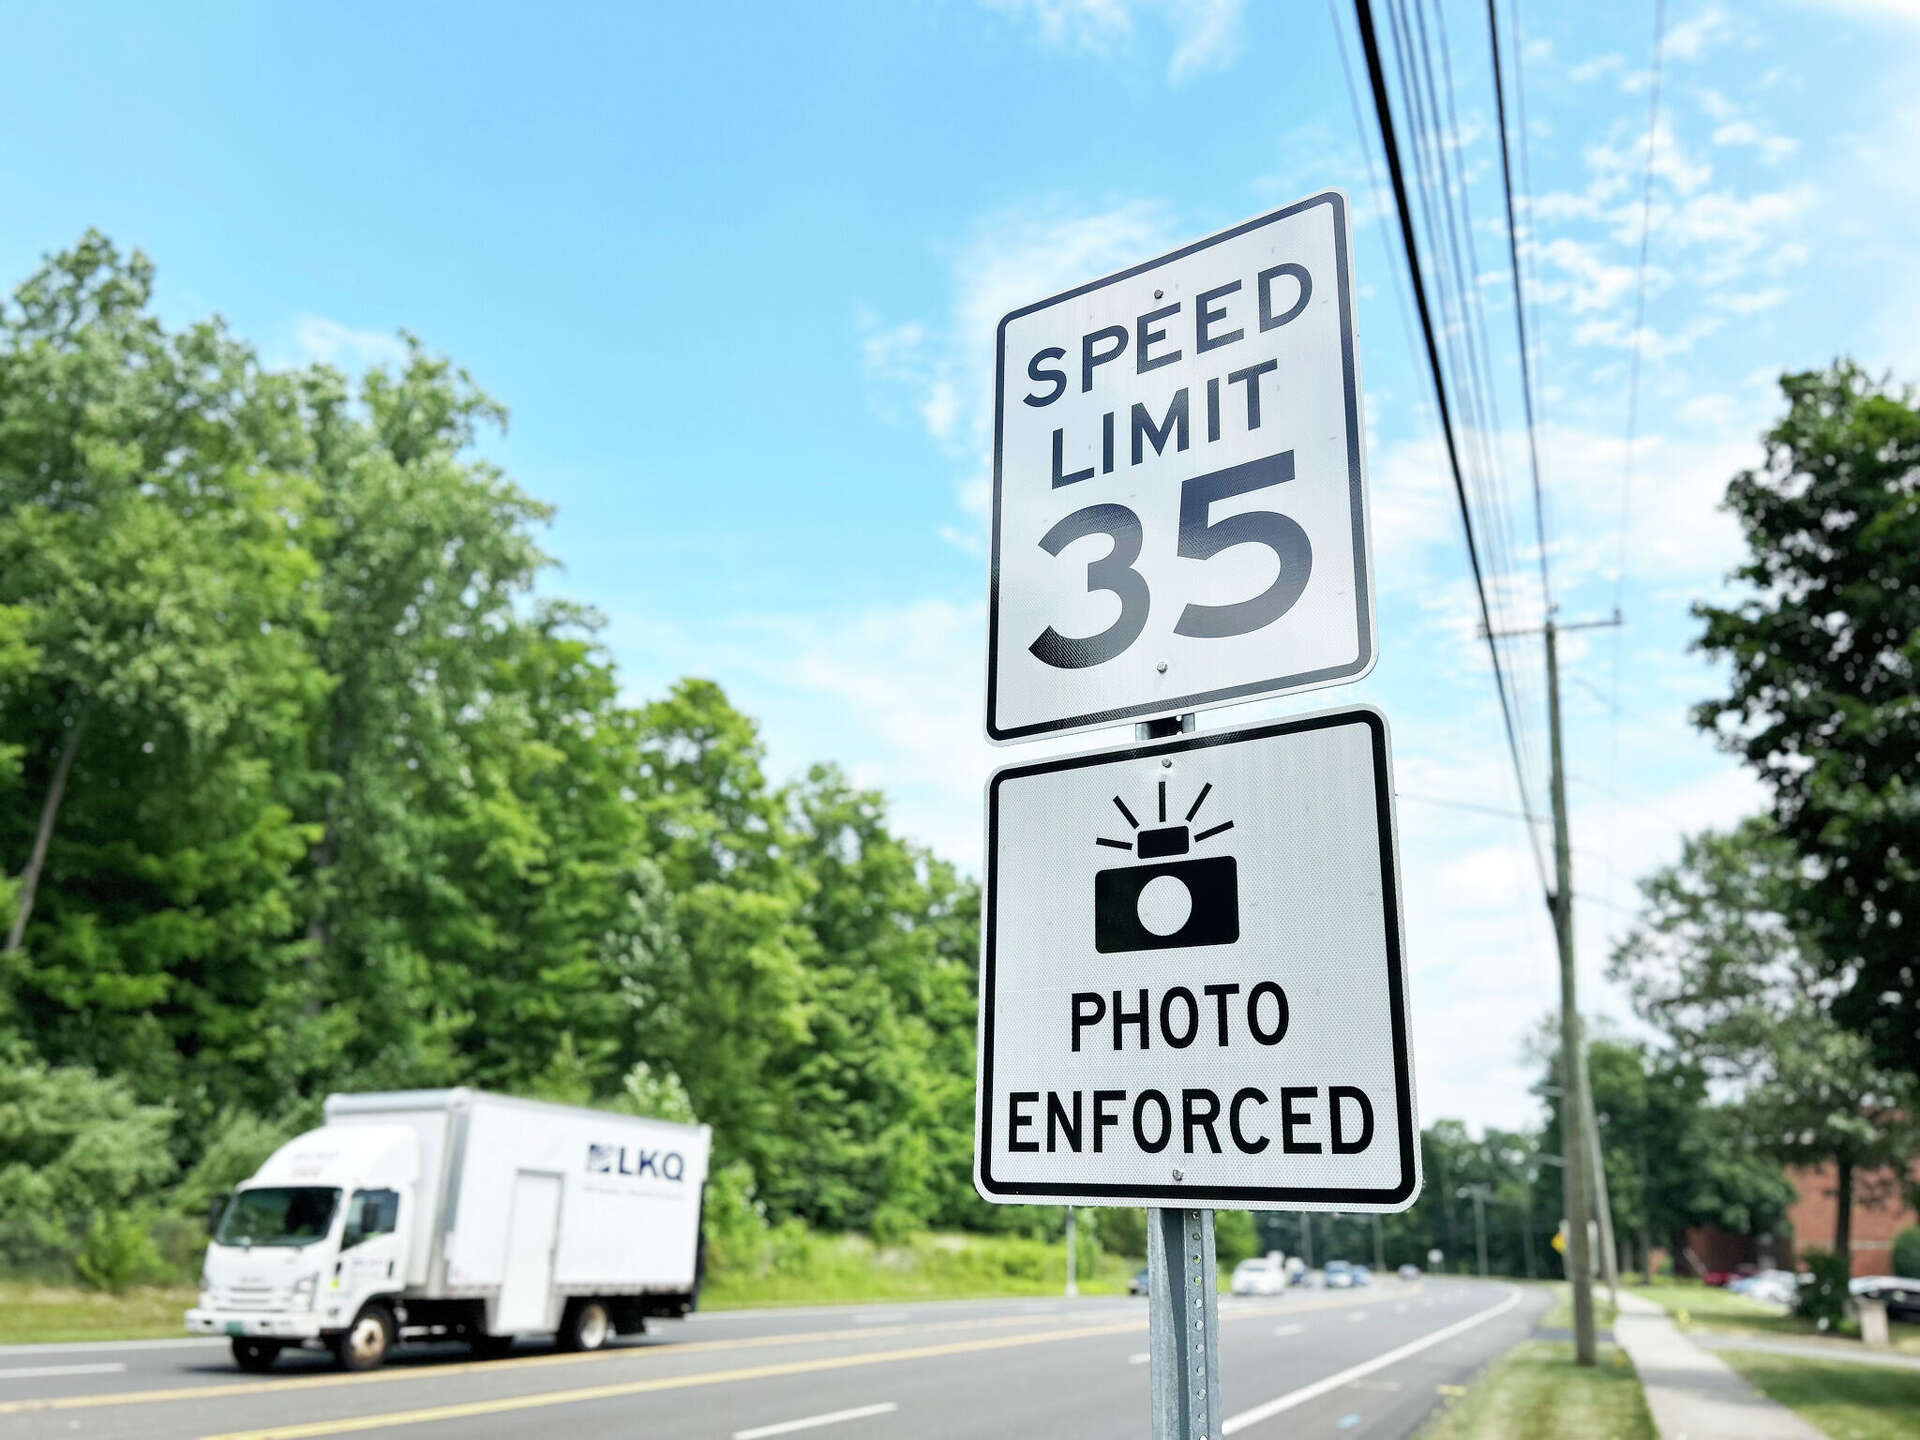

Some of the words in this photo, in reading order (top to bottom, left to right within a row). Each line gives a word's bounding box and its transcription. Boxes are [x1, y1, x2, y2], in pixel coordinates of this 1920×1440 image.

[1023, 263, 1313, 407] SPEED
[1052, 358, 1278, 489] LIMIT
[1029, 449, 1312, 669] 35
[1071, 981, 1289, 1052] PHOTO
[618, 1146, 685, 1183] LKQ
[1009, 1086, 1374, 1154] ENFORCED
